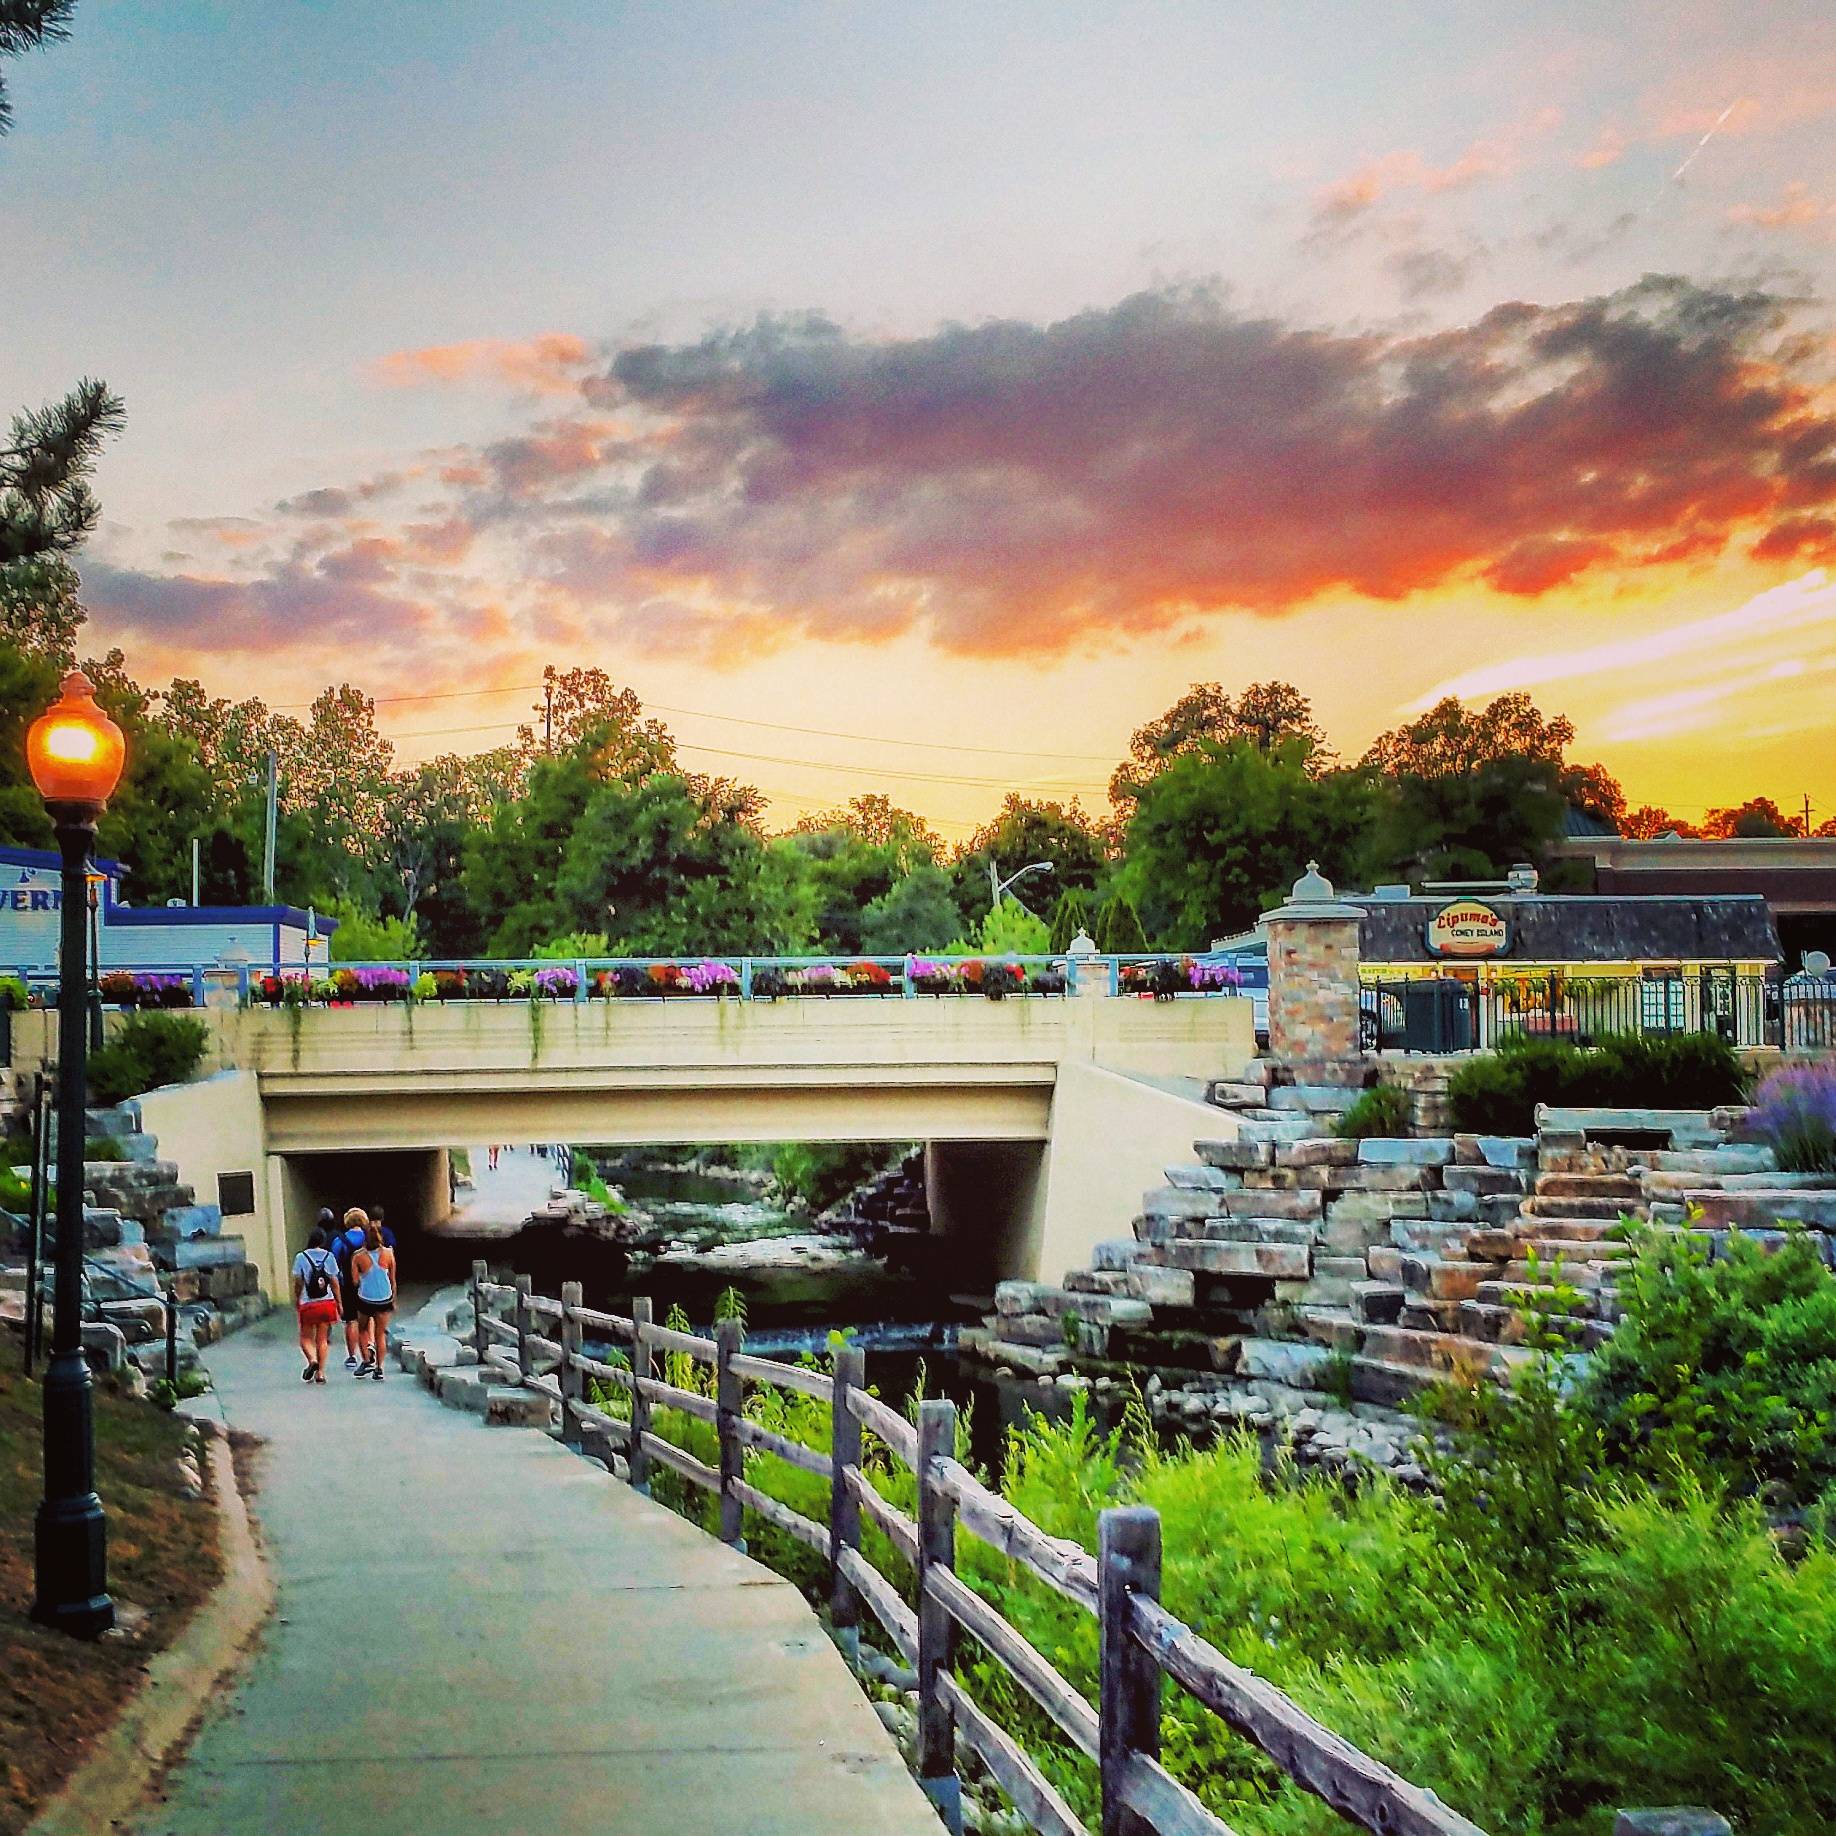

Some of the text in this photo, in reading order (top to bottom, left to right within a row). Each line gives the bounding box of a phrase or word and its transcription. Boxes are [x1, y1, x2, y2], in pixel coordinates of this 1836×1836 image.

[1437, 912, 1499, 929] Lipuma's
[1451, 929, 1504, 937] CONEY ISLAND
